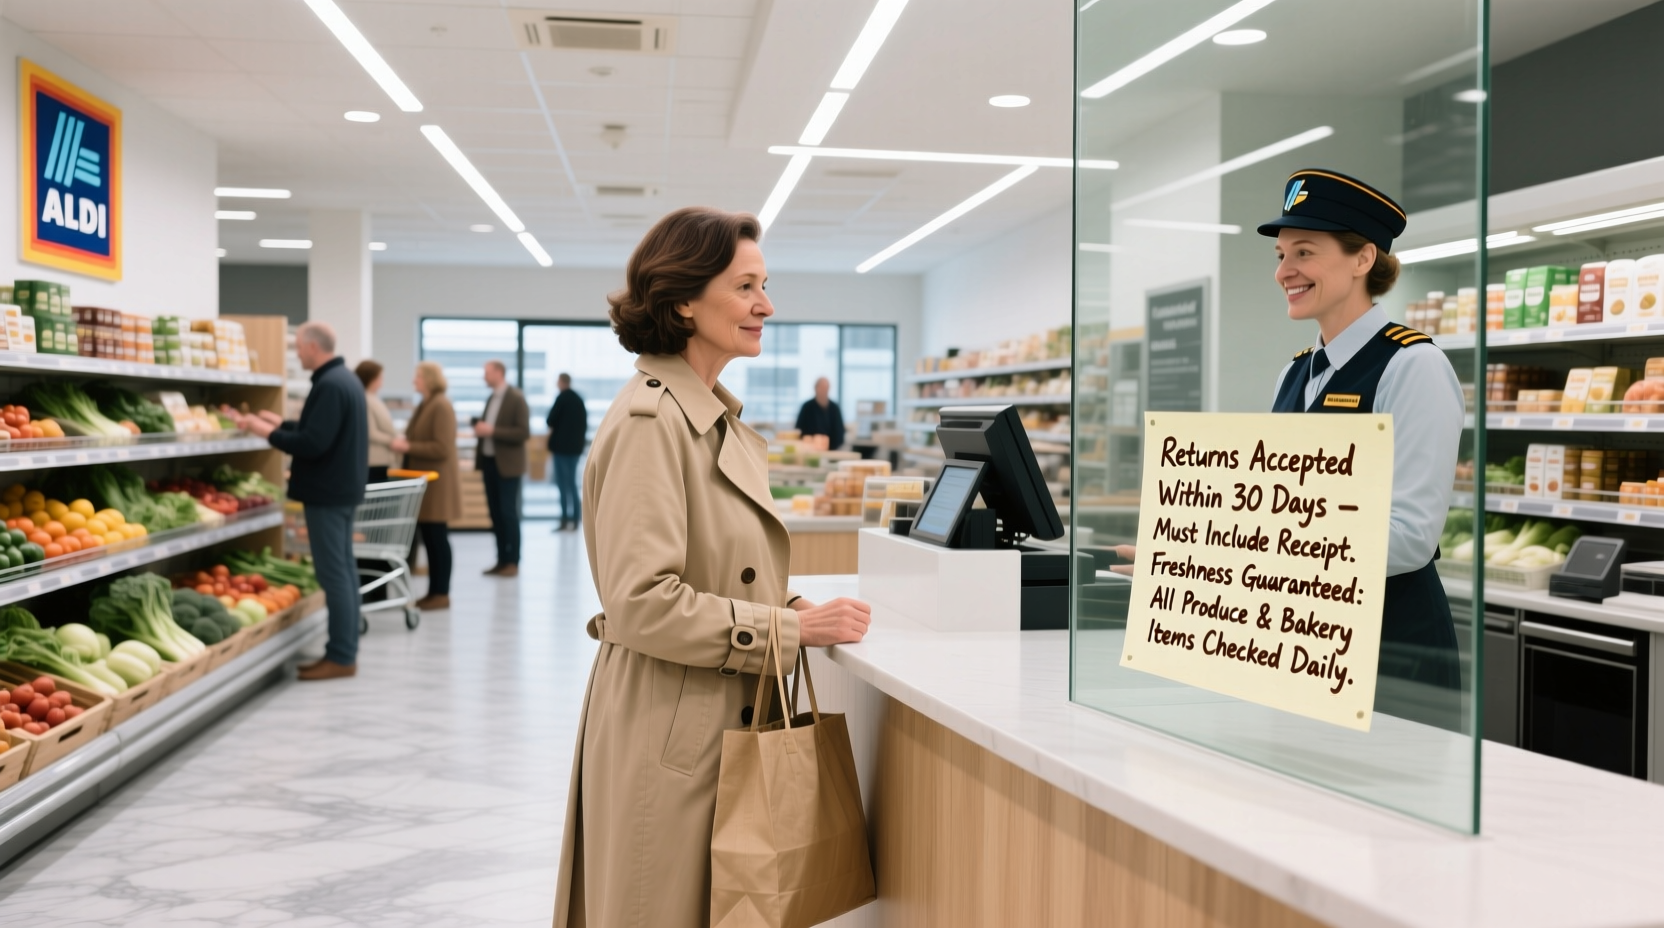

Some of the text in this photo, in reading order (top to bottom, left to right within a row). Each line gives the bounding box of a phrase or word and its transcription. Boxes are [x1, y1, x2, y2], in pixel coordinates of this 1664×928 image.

[42, 188, 106, 238] ALDI
[1161, 436, 1355, 486] Returns Accepted
[1159, 479, 1222, 508] Within
[1232, 483, 1262, 511] 30
[1271, 484, 1326, 528] Days
[1151, 552, 1233, 585] Freshness
[1153, 517, 1355, 571] Must Include Receipt.
[1150, 586, 1352, 655] All Produce & Bakery
[1148, 619, 1353, 694] Items Checked Daily.
